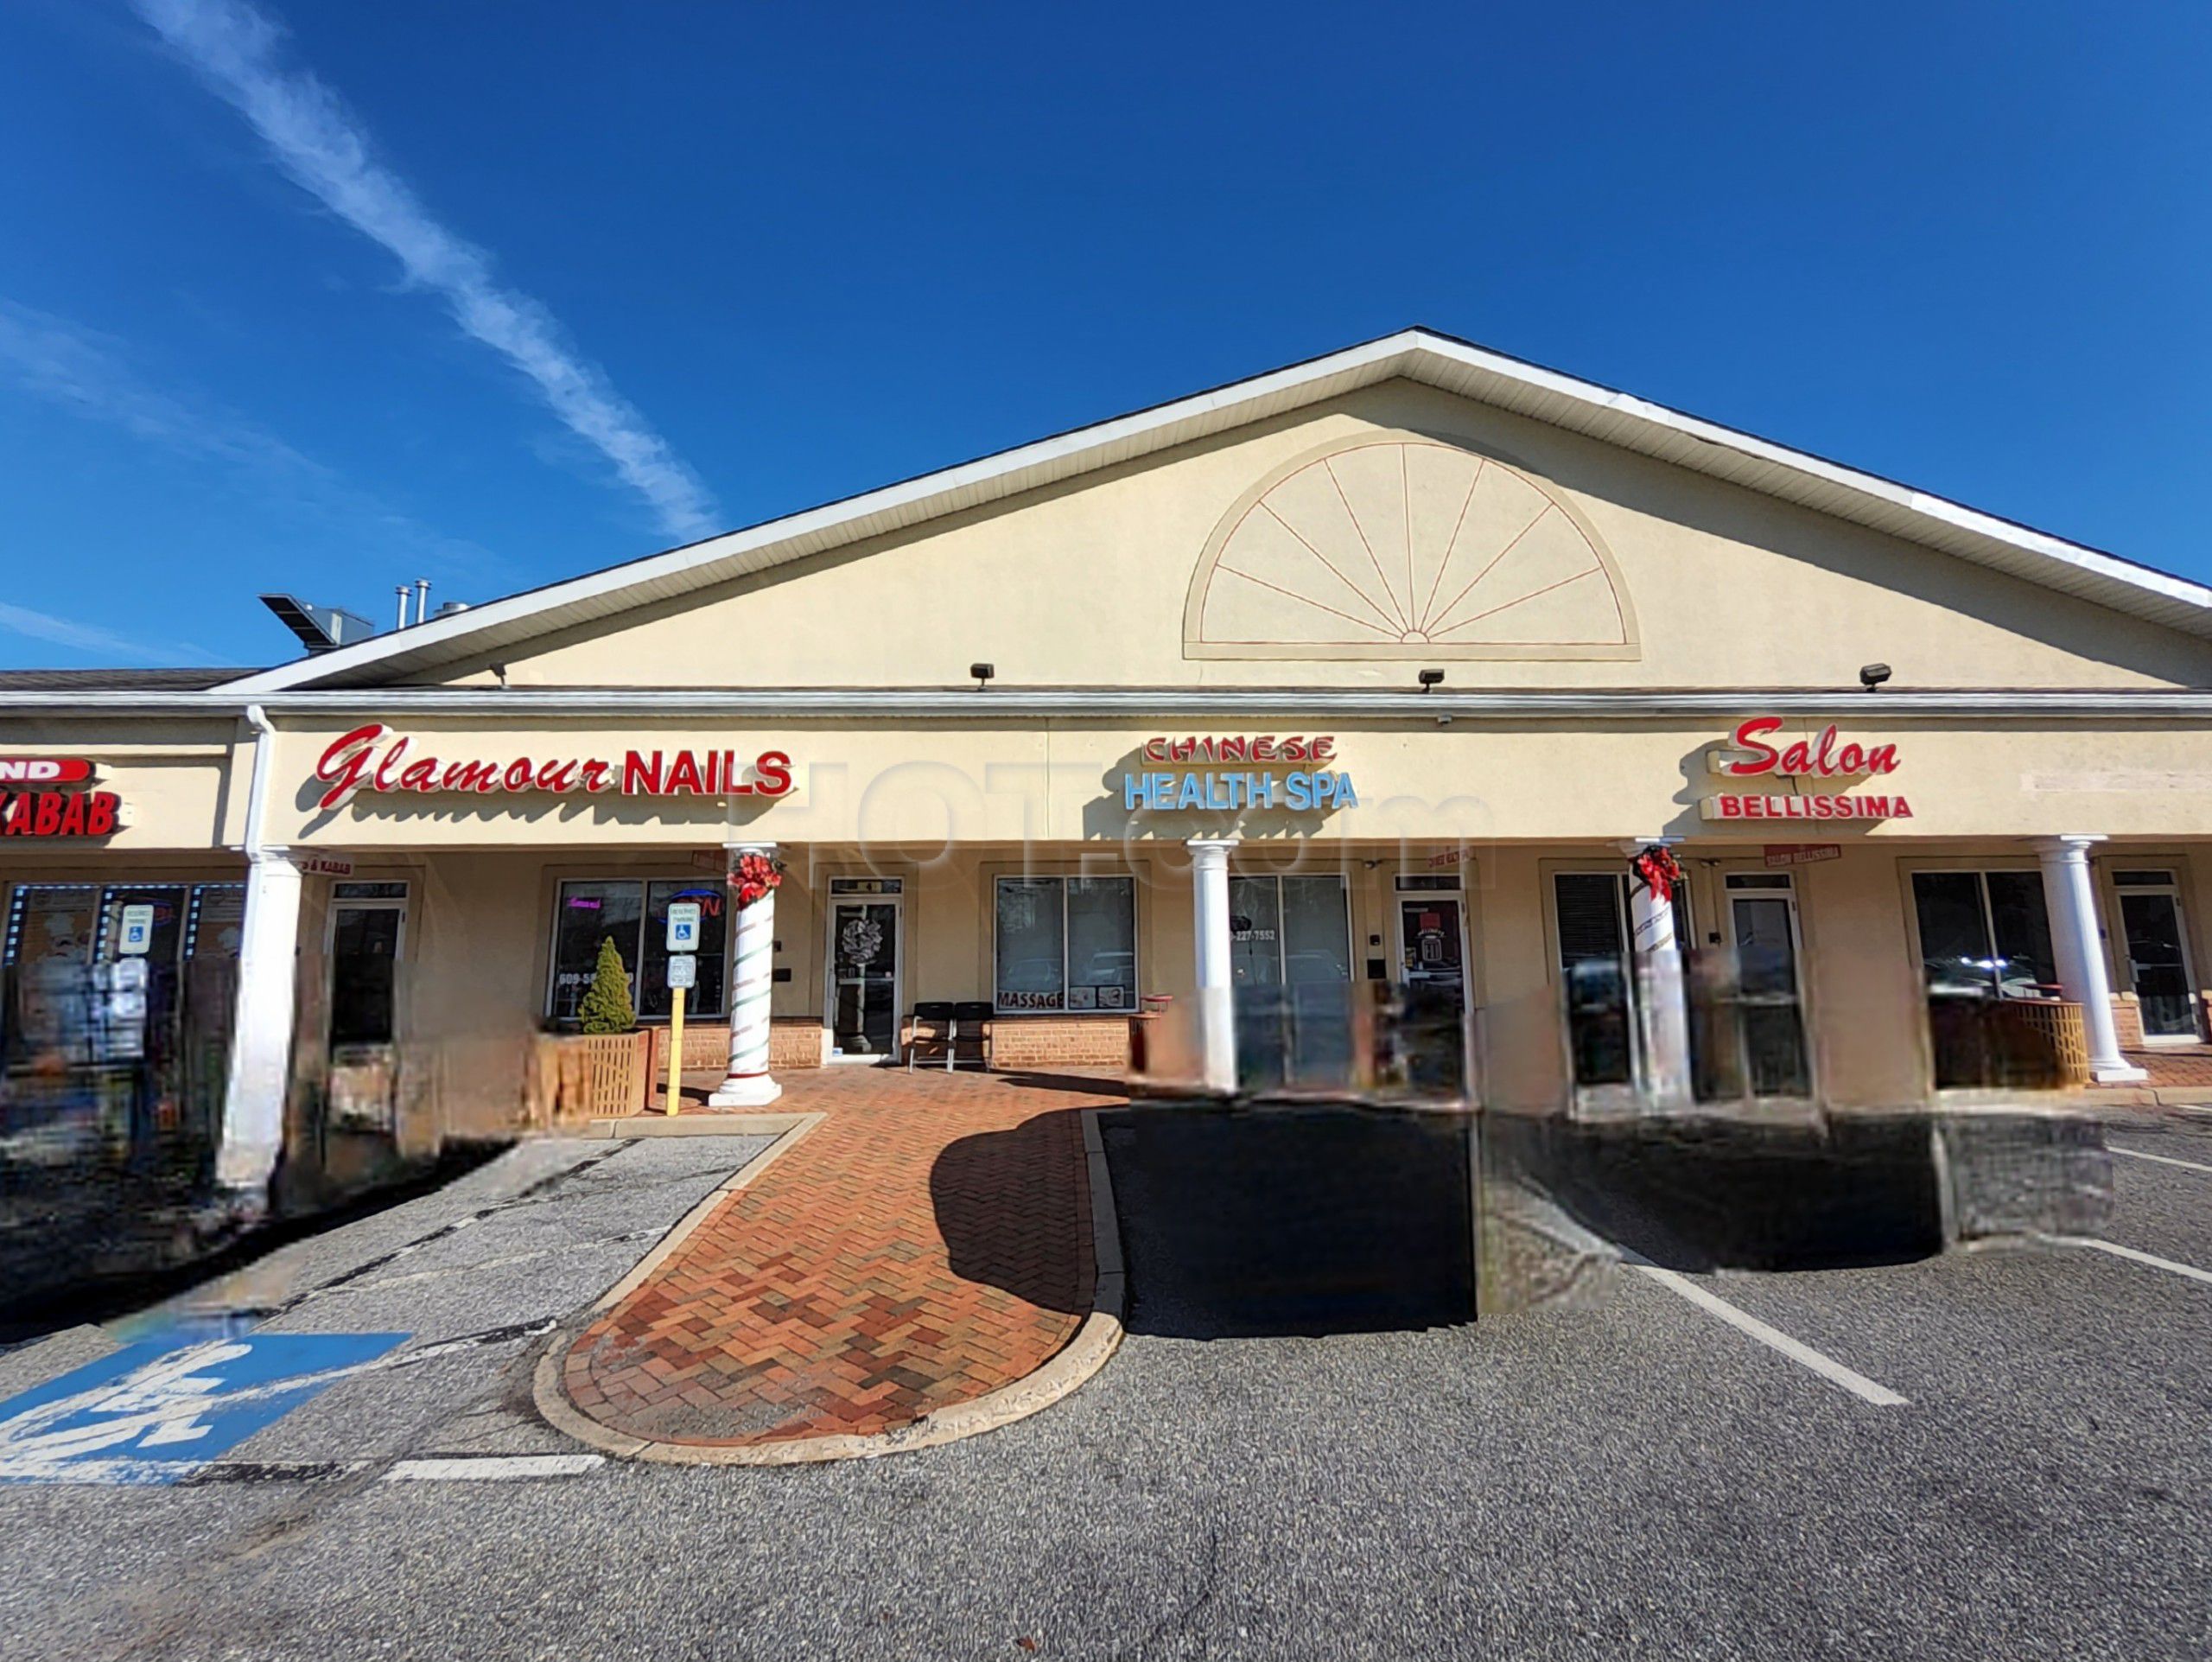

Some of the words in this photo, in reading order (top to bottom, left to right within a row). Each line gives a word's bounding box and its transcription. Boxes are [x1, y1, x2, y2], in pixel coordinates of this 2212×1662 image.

[1143, 735, 1338, 762] CHINESE
[1729, 716, 1901, 777] Salon
[316, 723, 611, 809] Glamour
[621, 749, 792, 796] NAILS
[1123, 771, 1274, 811] HEALTH
[1285, 771, 1360, 812] SPA
[1719, 794, 1914, 820] BELLISSIMA
[998, 992, 1065, 1009] MASSAGE
